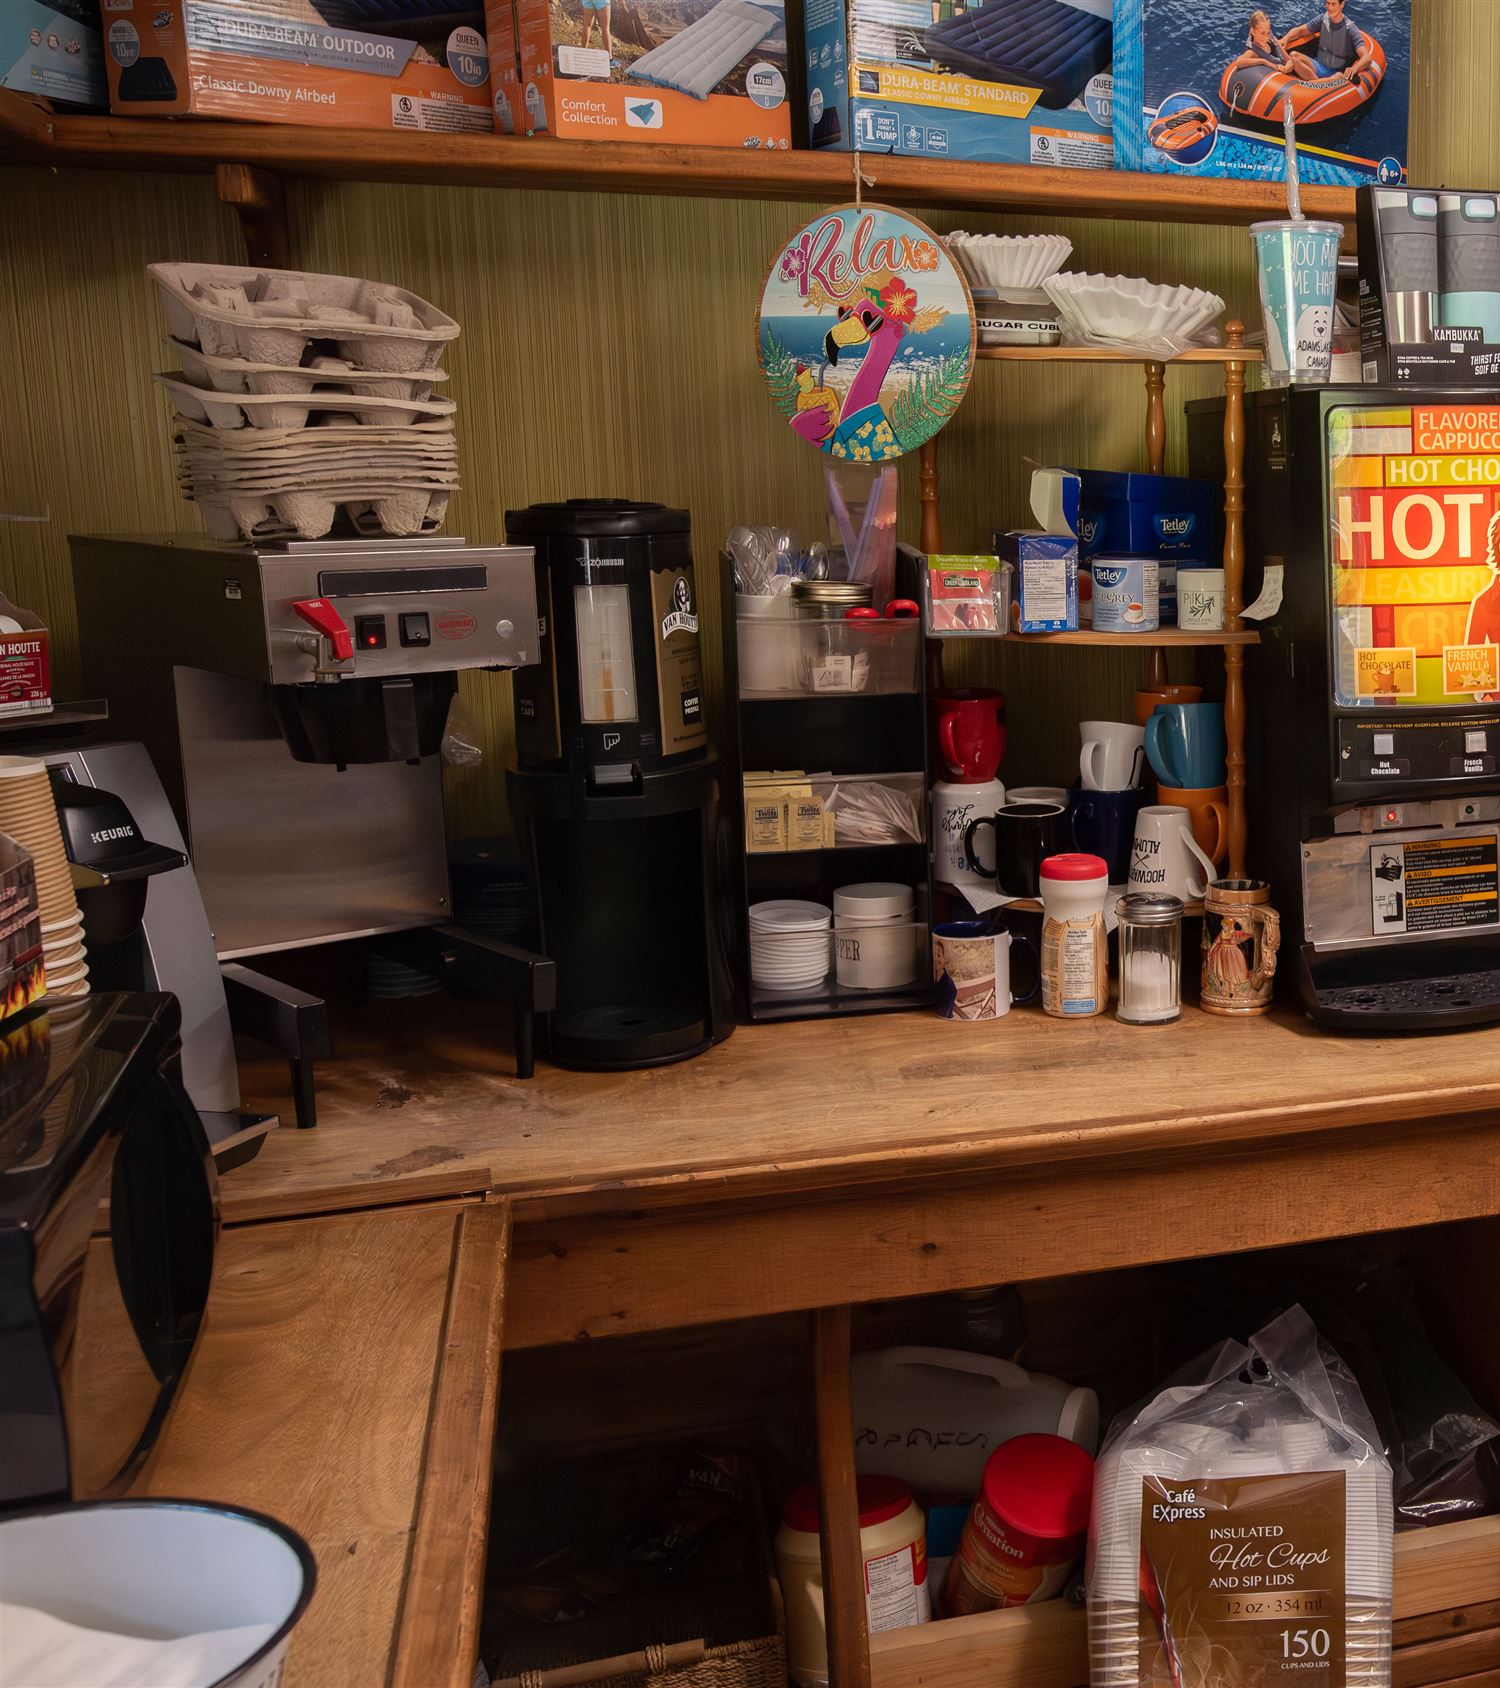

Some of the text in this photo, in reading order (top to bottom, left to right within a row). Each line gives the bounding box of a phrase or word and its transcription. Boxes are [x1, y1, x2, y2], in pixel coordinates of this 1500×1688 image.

[455, 32, 480, 47] QUEEN
[323, 35, 396, 61] OUTDOOR
[456, 54, 483, 77] 10in
[754, 75, 772, 86] 17cm
[198, 75, 337, 106] Classic Downy Airbed
[882, 73, 1030, 105] DURA-BEAM STANDARD
[430, 90, 465, 104] WARNING
[882, 88, 970, 106] CLASSIC DOWNY AIRBED
[561, 97, 607, 114] Comfort
[562, 110, 618, 126] Collection
[877, 117, 896, 126] DON'T
[876, 131, 898, 141] PUMP
[1067, 130, 1099, 142] WARNING
[799, 212, 921, 300] Relax
[1289, 240, 1316, 267] YOU
[1292, 270, 1310, 297] ME
[976, 319, 1024, 331] SUGAR
[1434, 329, 1480, 342] KAMBUKKA
[1470, 354, 1493, 366] THIRST
[1474, 364, 1490, 376] SOIF
[1490, 363, 1499, 374] DE
[1389, 459, 1443, 483] HOT
[1160, 518, 1190, 536] Tetley
[1337, 493, 1484, 560] HOT
[1095, 567, 1121, 583] Tetley
[1106, 591, 1136, 605] GREY
[663, 616, 677, 632] VAN
[8, 641, 41, 655] HOUTTE
[1359, 652, 1377, 662] HOT
[1447, 649, 1488, 662] FRENCH
[1359, 659, 1412, 671] CHOCOLATE
[1447, 660, 1490, 673] VANILLA
[30, 690, 40, 698] 226
[1379, 761, 1390, 769] Hot
[1464, 758, 1483, 767] French
[1464, 764, 1484, 773] Vanilla
[1371, 767, 1400, 775] Chocolate
[756, 808, 779, 819] TWIN
[800, 805, 820, 816] TWIN
[91, 825, 134, 844] KEURIG
[1411, 842, 1442, 851] WARNING
[1414, 895, 1464, 906] AVERTISSEMENT
[1166, 1488, 1195, 1504] Café
[1152, 1504, 1206, 1523] EXpress
[1209, 1525, 1284, 1540] INSULATED
[1209, 1541, 1331, 1571] Hot Cups
[1208, 1573, 1295, 1588] AND SIP LIDS
[1226, 1597, 1323, 1615] 12 oz 354 ml
[1279, 1628, 1331, 1658] 150
[1280, 1660, 1331, 1670] CUPS AND LIDS
